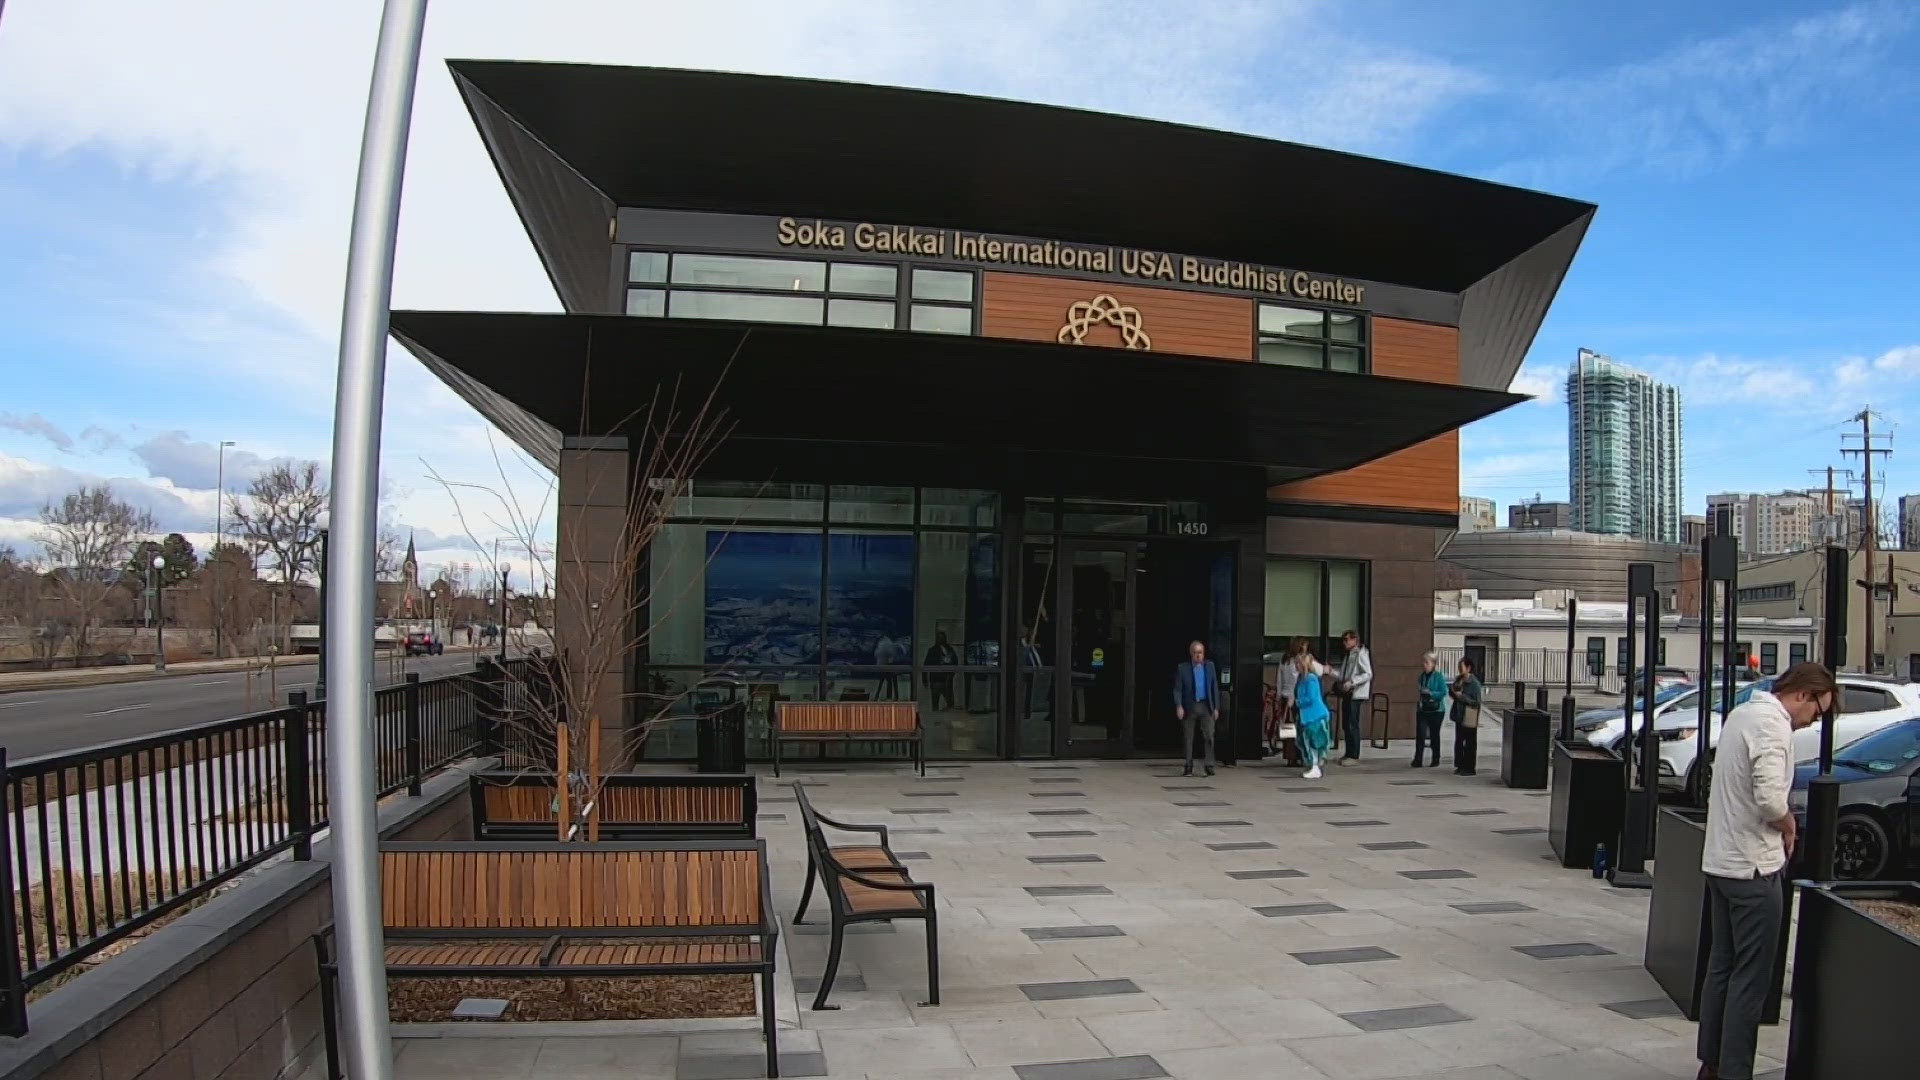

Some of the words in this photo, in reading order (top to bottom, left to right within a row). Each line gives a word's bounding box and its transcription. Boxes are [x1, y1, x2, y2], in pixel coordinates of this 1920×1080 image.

[778, 217, 845, 247] Soka
[854, 223, 946, 255] Gakkai
[953, 231, 1114, 272] International
[1121, 250, 1175, 279] USA
[1182, 256, 1287, 293] Buddhist
[1293, 271, 1365, 303] Center
[1177, 522, 1208, 535] 1450
